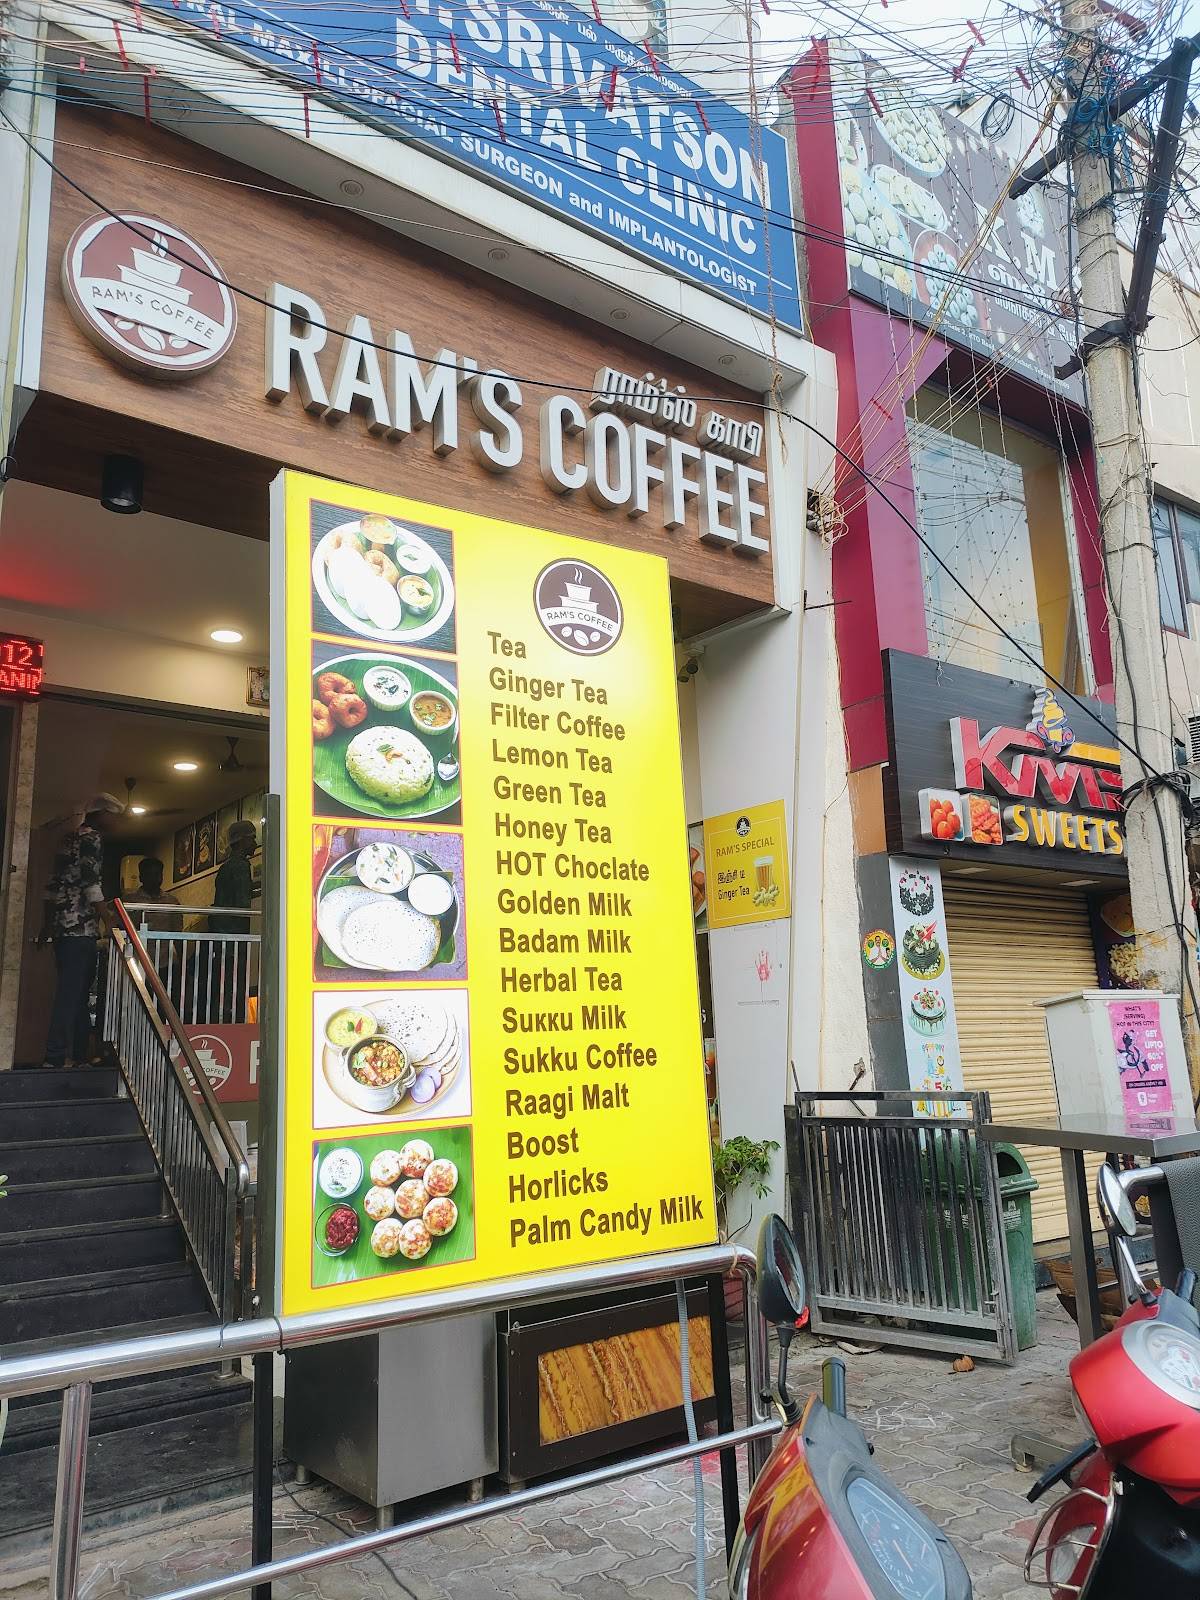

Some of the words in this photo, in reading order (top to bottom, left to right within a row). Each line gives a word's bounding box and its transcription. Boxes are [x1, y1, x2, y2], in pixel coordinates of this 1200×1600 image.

[464, 0, 772, 209] SRIVATSON
[396, 17, 602, 173] DENTAL
[616, 146, 758, 254] CLINIC
[460, 132, 564, 199] SURGEON
[569, 190, 602, 219] and
[608, 207, 757, 296] IMPLANTOLOGIST
[91, 285, 144, 306] RAM'S
[149, 298, 216, 340] COFFEE
[265, 282, 524, 474] RAM'S
[540, 394, 769, 556] COFFEE
[547, 610, 575, 622] RAM'S
[577, 612, 614, 632] COFFEE
[487, 630, 527, 659] Tea
[489, 667, 565, 702] Ginger
[571, 679, 608, 705] Tea
[490, 702, 549, 732] Filter
[557, 711, 626, 741] Coffee
[492, 738, 569, 769] Lemon
[575, 748, 613, 774] Tea
[493, 775, 562, 804] Green
[569, 782, 607, 807] Tea
[495, 812, 567, 847] Honey
[574, 818, 612, 844] Tea
[1008, 803, 1123, 855] SWEETS
[716, 843, 740, 858] RAM'S
[741, 836, 775, 852] SPECIAL
[496, 850, 546, 877] HOT
[554, 853, 650, 881] Choclate
[497, 888, 580, 915] Golden
[588, 892, 632, 917] Milk
[718, 888, 738, 901] Ginger
[738, 885, 750, 897] Tea
[499, 927, 579, 953] Badam
[587, 929, 632, 953] Milk
[501, 967, 577, 993] Herbal
[584, 966, 623, 991] Tea
[581, 1004, 627, 1031] Milk
[504, 1046, 578, 1075] Sukku
[586, 1042, 657, 1070] Coffee
[1150, 1064, 1164, 1072] OFF
[505, 1085, 574, 1120] Raagi
[582, 1082, 630, 1111] Malt
[507, 1127, 579, 1160] Boost
[508, 1167, 609, 1203] Horlicks
[510, 1215, 571, 1248] Palm
[580, 1202, 652, 1236] Candy
[659, 1194, 704, 1226] Milk
